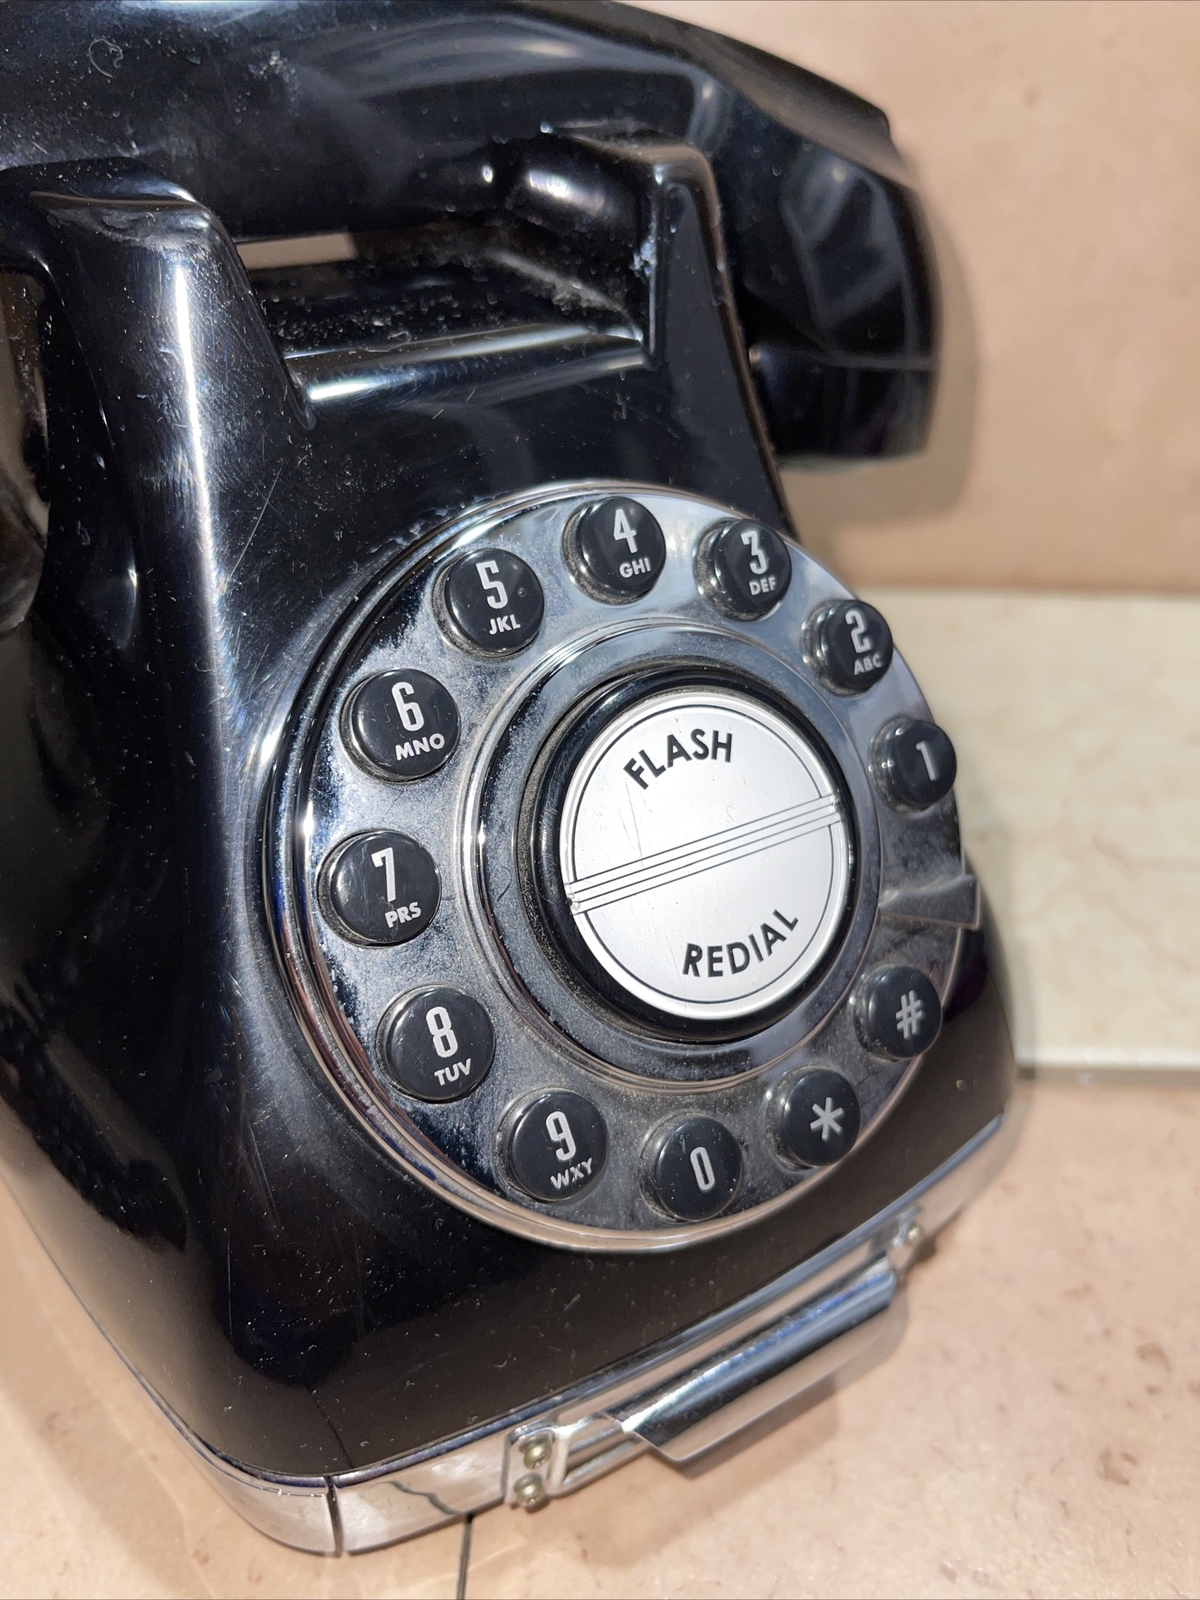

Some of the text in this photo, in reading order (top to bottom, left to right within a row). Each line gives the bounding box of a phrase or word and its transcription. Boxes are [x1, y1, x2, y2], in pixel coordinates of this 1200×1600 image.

[613, 507, 638, 554] 4
[741, 529, 768, 575] 3
[476, 560, 509, 610] 5
[619, 557, 652, 578] GHI
[748, 576, 777, 596] DEF
[489, 614, 521, 635] JKL
[845, 609, 871, 653] 2
[853, 653, 882, 675] ABC
[391, 681, 425, 732] 6
[395, 732, 445, 760] MNO
[623, 728, 734, 790] FLASH
[915, 741, 936, 781] 1
[371, 846, 397, 902] 7
[385, 901, 422, 928] PRS
[682, 909, 800, 979] REDIAL
[425, 1006, 459, 1058] 8
[434, 1057, 472, 1086] TUV
[545, 1110, 577, 1162] 9
[550, 1158, 593, 1190] WXY
[689, 1146, 716, 1191] 0
